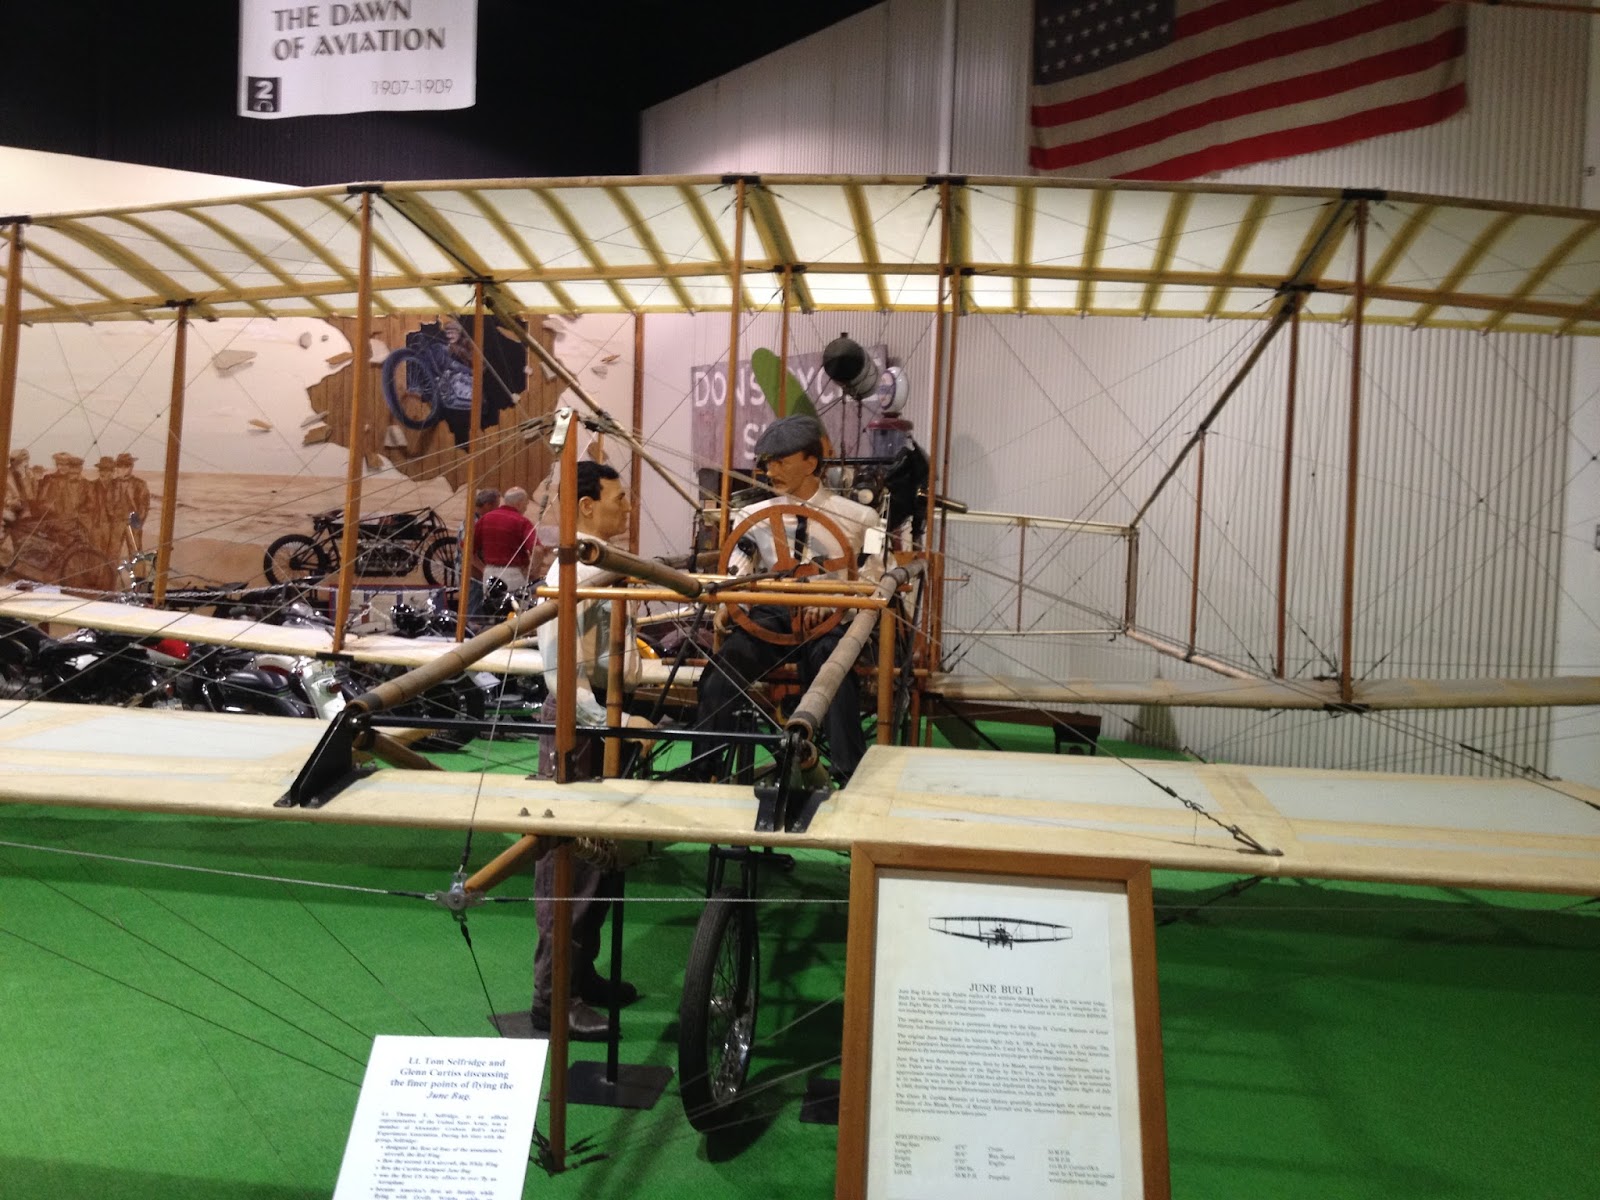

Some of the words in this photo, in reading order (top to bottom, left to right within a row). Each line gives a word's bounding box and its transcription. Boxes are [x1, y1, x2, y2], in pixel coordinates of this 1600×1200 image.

[273, 6, 320, 31] THE
[330, 0, 412, 26] DAWN
[272, 36, 304, 60] OF
[313, 26, 446, 57] AVIATION
[255, 80, 274, 99] 2
[372, 78, 454, 96] 1907-1909
[969, 983, 997, 993] JUNE
[1001, 985, 1022, 995] BUG
[1026, 986, 1034, 996] II
[408, 1057, 421, 1065] Lt.
[425, 1057, 444, 1065] Tom
[447, 1058, 486, 1068] Selfridge
[400, 1067, 426, 1076] Glenn
[429, 1068, 461, 1076] Curtiss
[464, 1070, 509, 1079] discussing
[430, 1080, 457, 1089] points
[472, 1081, 497, 1090] flying
[426, 1091, 449, 1099] June
[451, 1092, 471, 1101] Bug.
